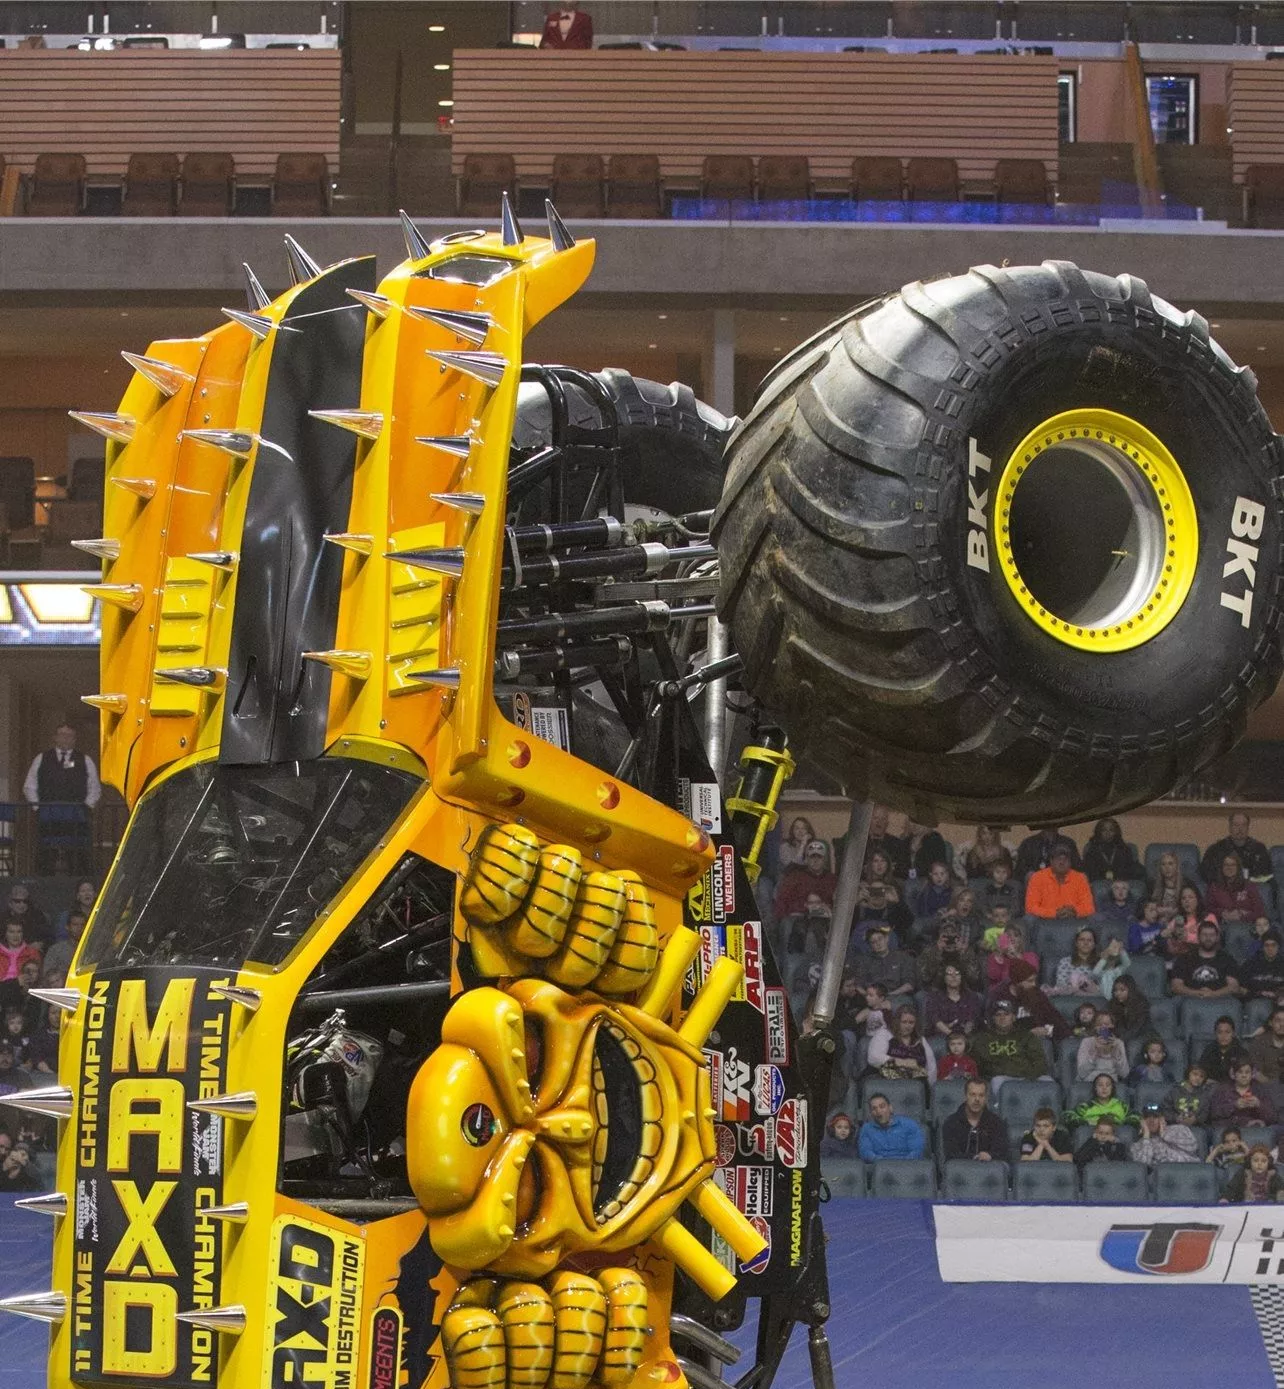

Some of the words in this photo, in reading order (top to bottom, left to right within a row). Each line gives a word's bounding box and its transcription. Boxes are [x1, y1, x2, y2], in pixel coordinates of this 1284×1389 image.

[966, 436, 992, 573] BKT
[1220, 495, 1266, 629] BKT
[713, 859, 724, 919] LINCOLN
[724, 853, 733, 906] WELDERS
[744, 922, 762, 1009] ARP
[767, 995, 781, 1058] DERALE
[80, 980, 111, 1168] CHAMPION
[723, 1046, 750, 1107] K&N
[761, 1068, 771, 1108] LUCAS
[746, 1168, 761, 1214] Holley
[790, 1169, 803, 1267] MAGNAFLOW
[75, 1251, 93, 1336] TIME
[336, 1241, 360, 1364] DESTRUCTION
[75, 1349, 91, 1372] 11
